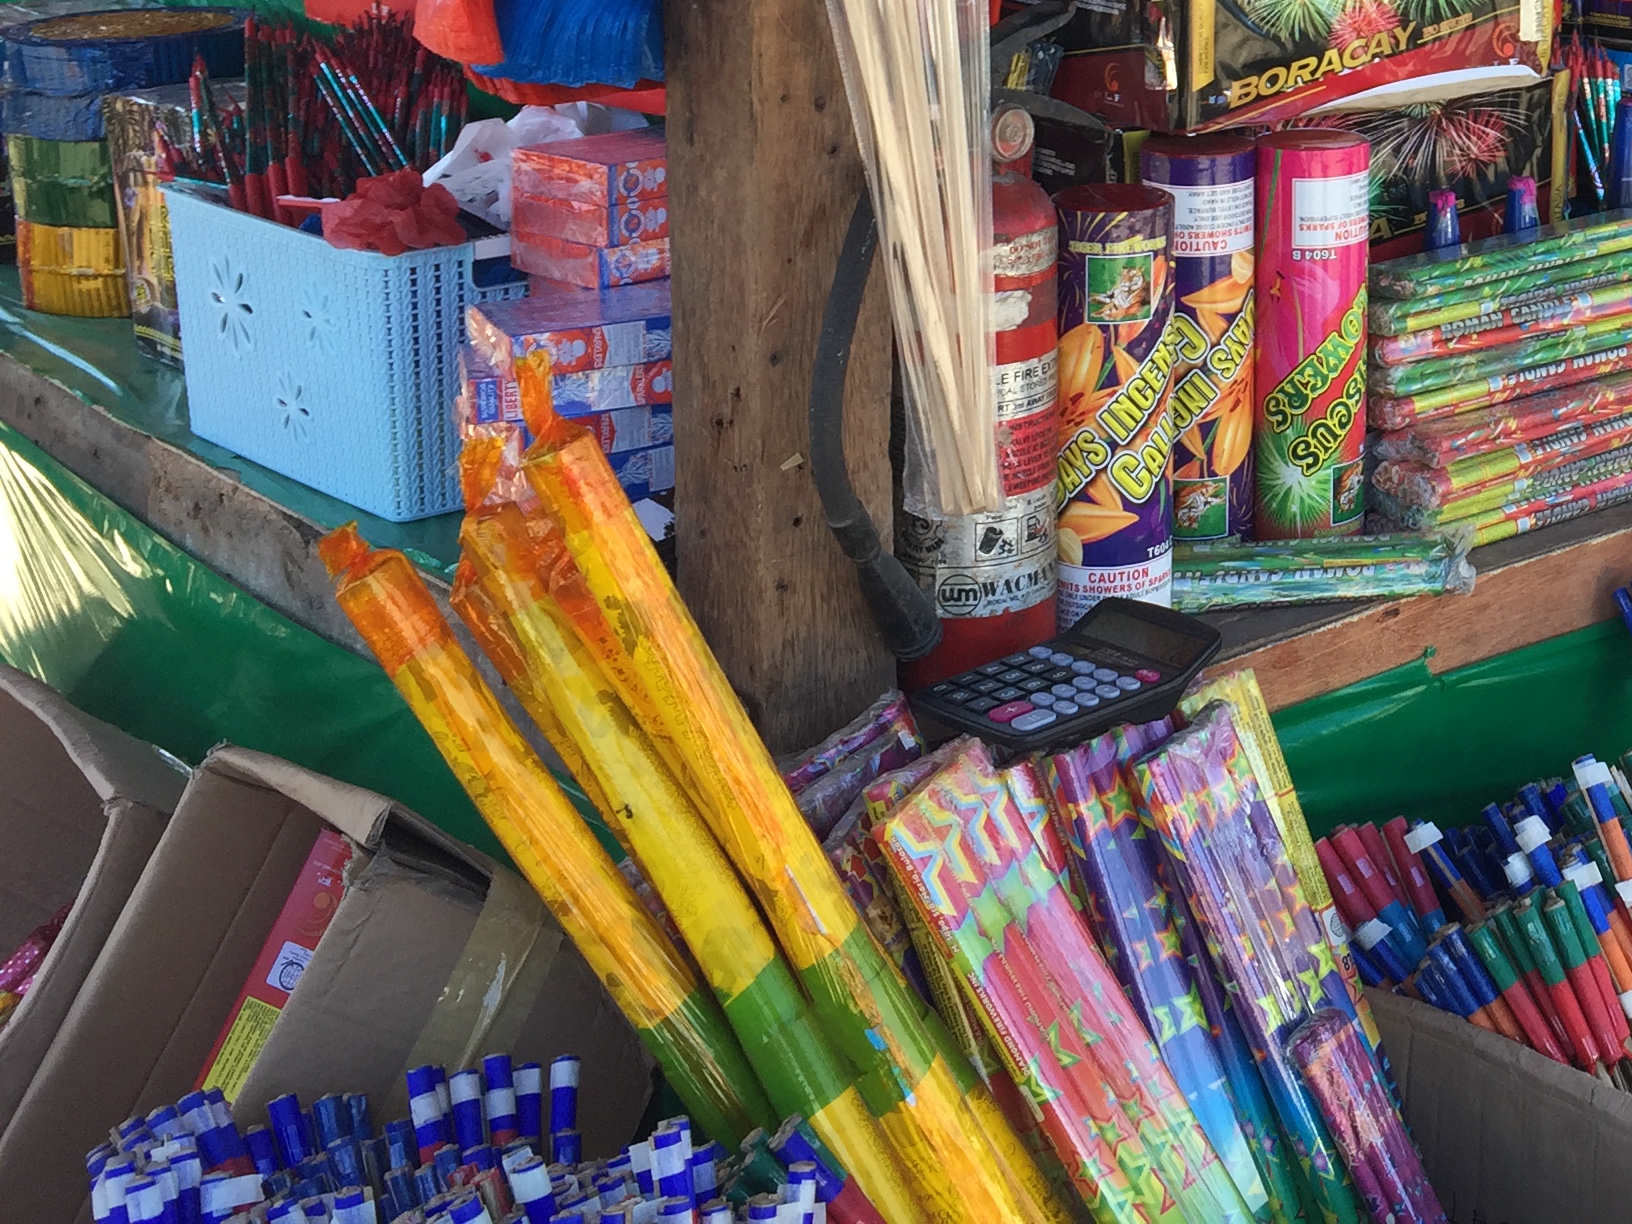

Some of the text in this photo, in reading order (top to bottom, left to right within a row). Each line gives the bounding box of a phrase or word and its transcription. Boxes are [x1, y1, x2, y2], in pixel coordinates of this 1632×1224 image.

[1229, 21, 1418, 108] BORACAY
[1298, 222, 1335, 233] SPARKS
[1305, 249, 1337, 261] T604
[1440, 312, 1503, 340] ROMAN
[1265, 284, 1367, 429] LOWERS
[1013, 364, 1040, 382] FIRE
[1082, 581, 1132, 594] SHOWERS
[1134, 578, 1148, 589] OF
[1088, 567, 1150, 583] CAUTION
[973, 985, 1010, 1036] FIREWORKS
[1001, 1034, 1032, 1076] DIAMOND
